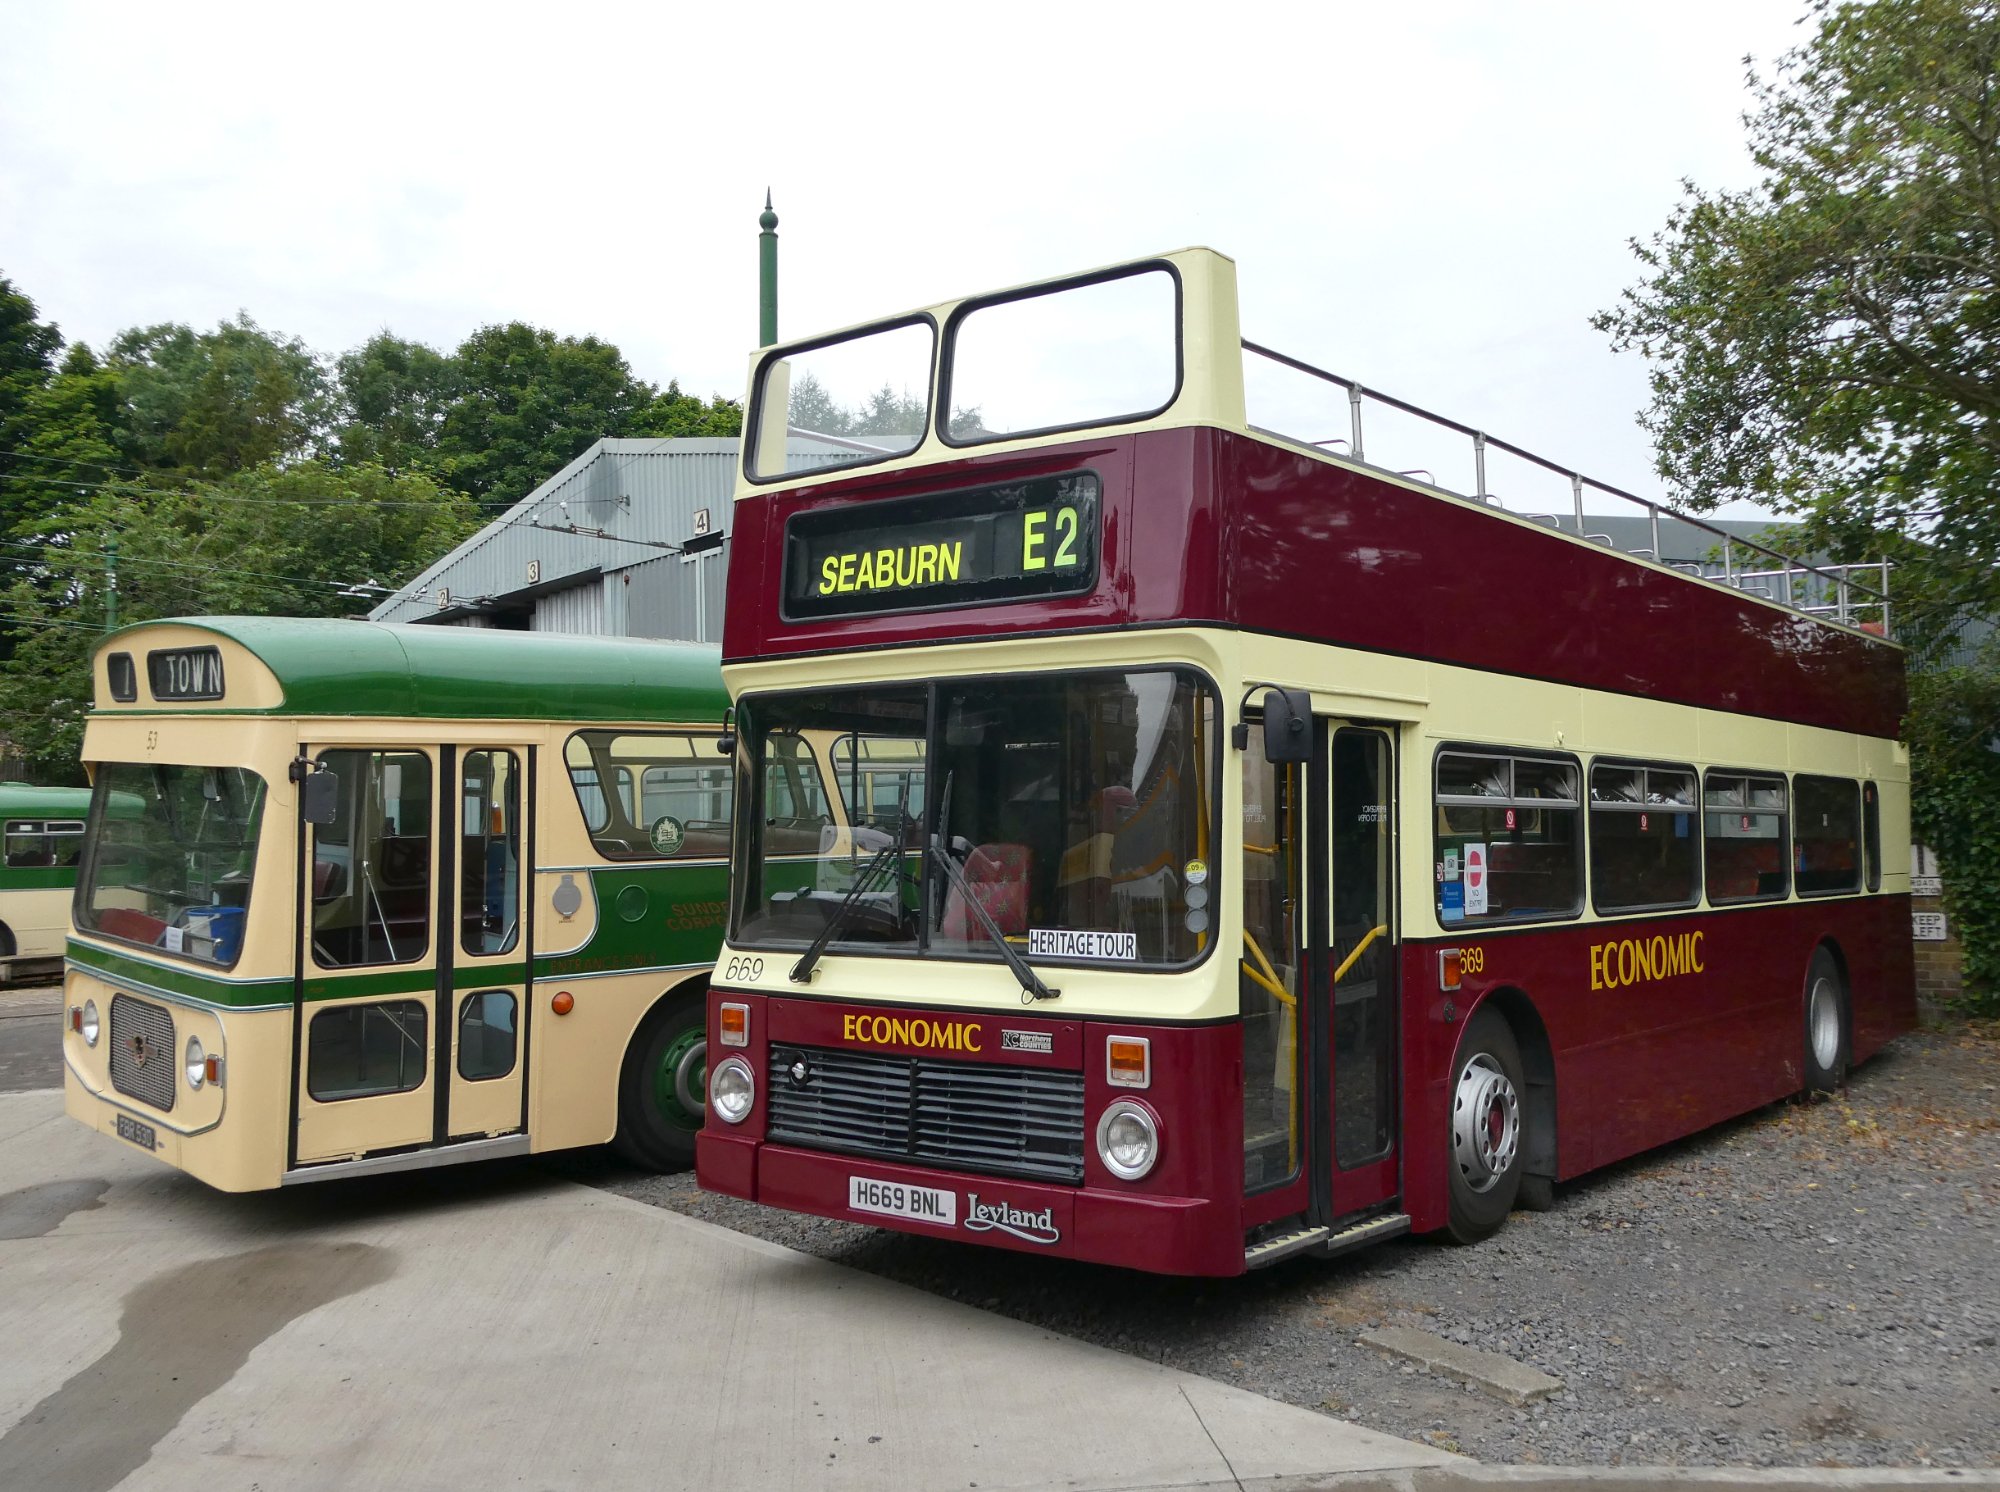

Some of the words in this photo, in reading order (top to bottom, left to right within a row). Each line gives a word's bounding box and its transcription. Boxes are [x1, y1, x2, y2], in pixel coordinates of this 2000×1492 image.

[696, 514, 706, 531] 4
[819, 541, 962, 595] SEABURN
[1023, 506, 1079, 571] E2
[529, 565, 537, 581] 3
[439, 593, 447, 607] 2
[124, 659, 130, 695] 1
[166, 653, 222, 693] TOWN
[146, 730, 158, 751] 53
[1471, 889, 1480, 897] NO
[1912, 914, 1941, 926] KEEP
[1913, 926, 1942, 938] LEFT
[1030, 931, 1094, 956] HERITAGE
[1096, 934, 1134, 958] TOUR
[725, 956, 764, 982] 669
[1590, 930, 1704, 991] ECONOMIC
[843, 1014, 982, 1052] ECONOMIC
[857, 1181, 905, 1211] H669
[910, 1190, 947, 1218] BNL
[965, 1192, 1059, 1242] Leyland
